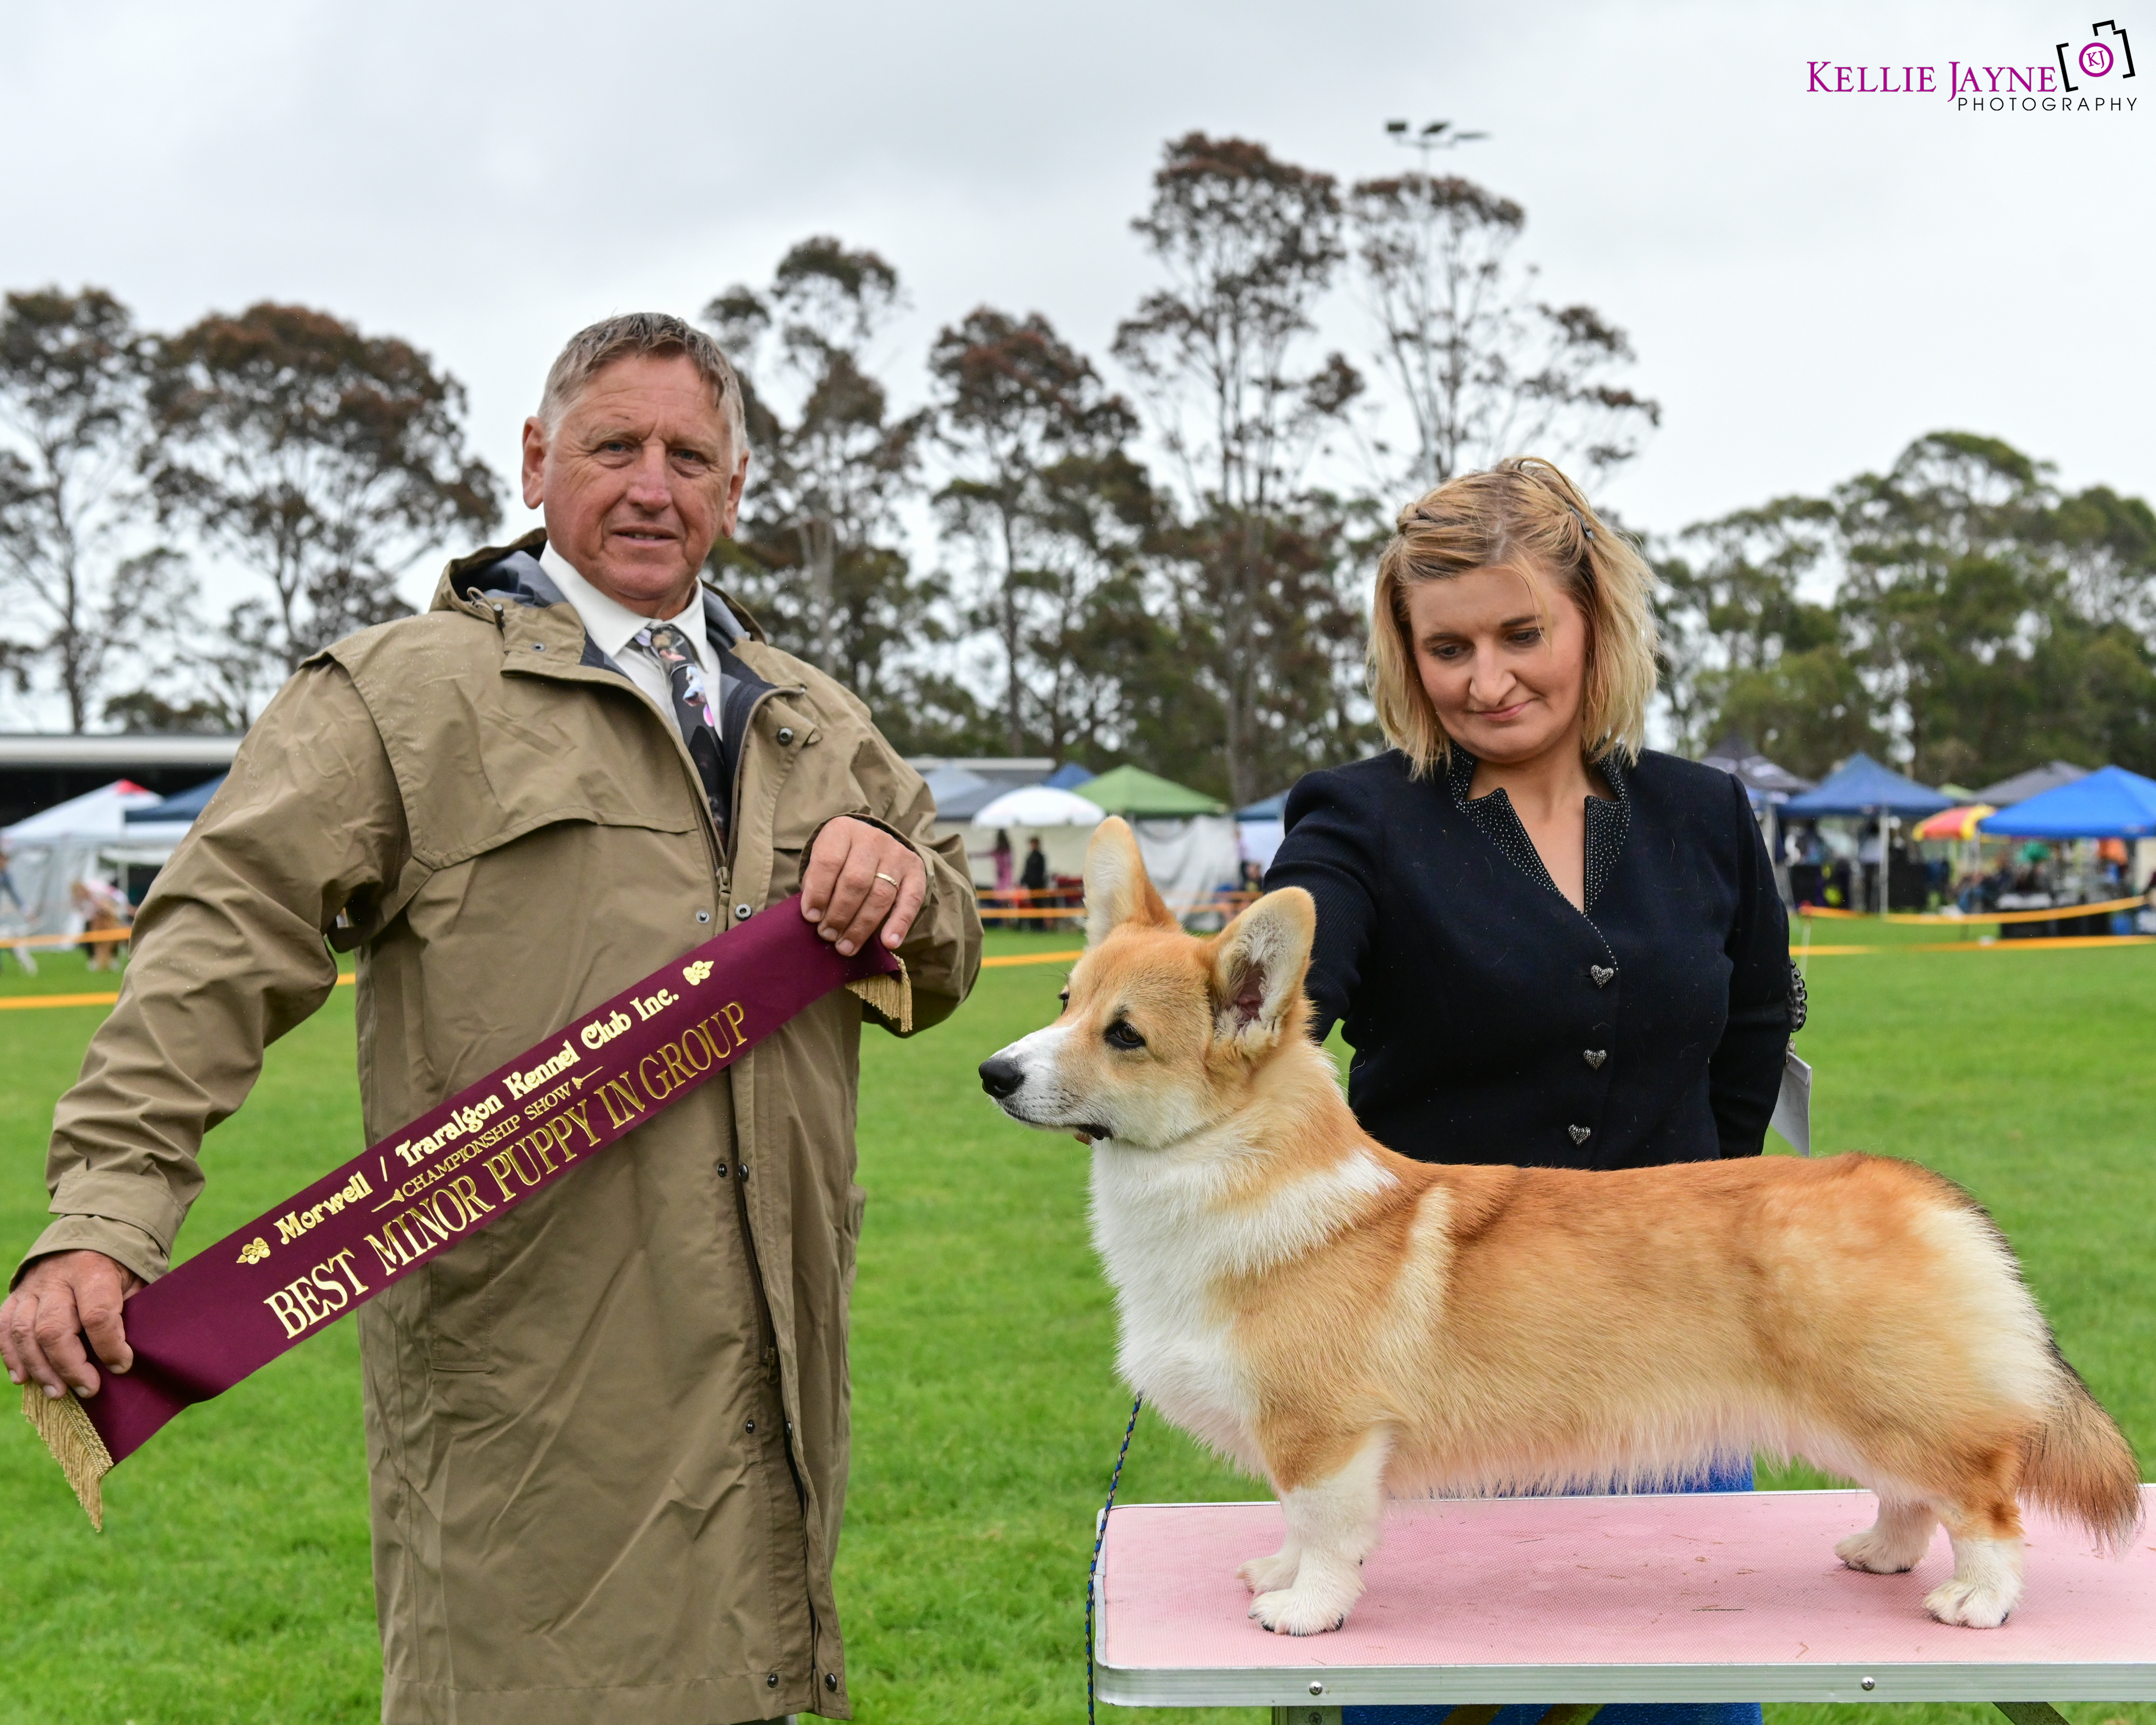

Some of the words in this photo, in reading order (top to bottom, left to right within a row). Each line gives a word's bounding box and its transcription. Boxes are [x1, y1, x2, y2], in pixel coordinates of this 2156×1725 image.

[264, 1247, 369, 1338] BEST
[364, 1174, 496, 1276] MINOR
[483, 1098, 602, 1202] PUPPY
[593, 1071, 645, 1130] IN
[639, 1001, 748, 1100] GROUP
[274, 1171, 372, 1244] Morwell
[395, 1095, 503, 1167] Traralgon
[502, 1040, 579, 1101] Kennel
[581, 1010, 631, 1050] Club
[630, 988, 680, 1021] Inc.
[402, 1115, 520, 1198] CHAMPIONSHIP
[524, 1082, 572, 1121] SHOW
